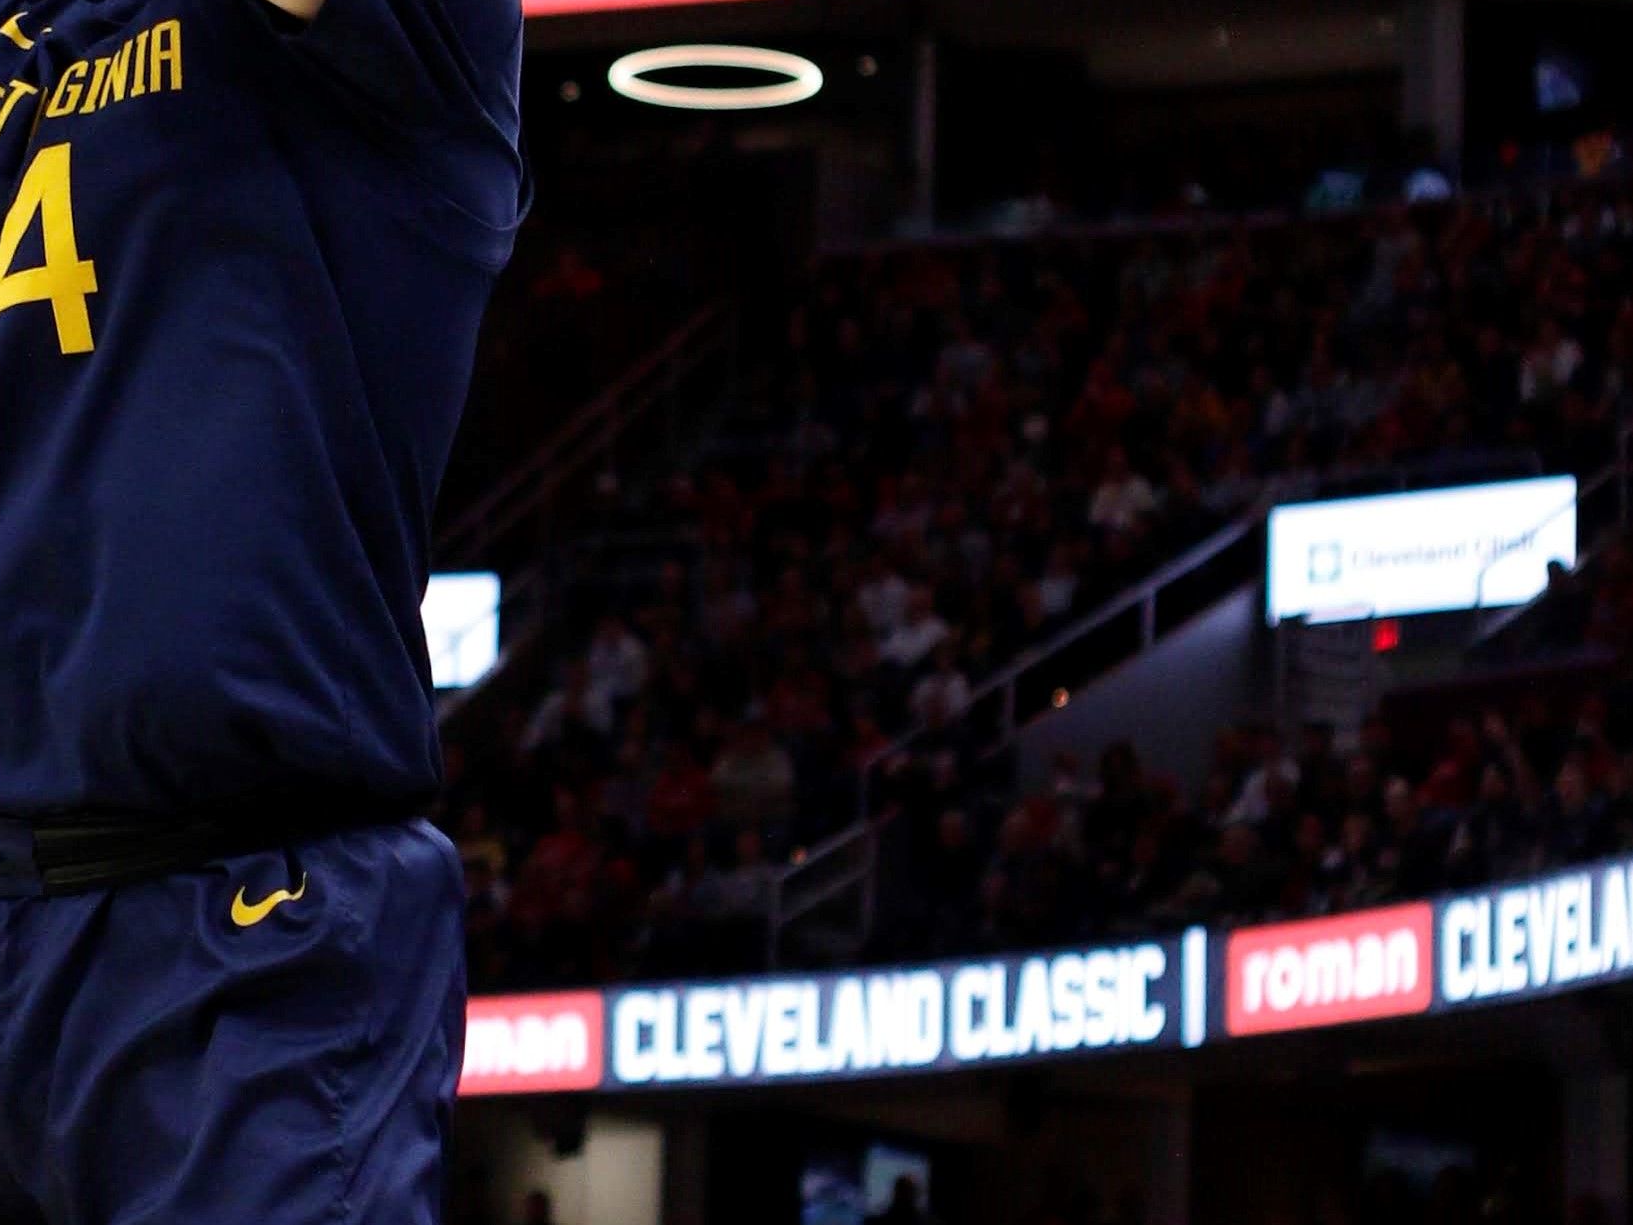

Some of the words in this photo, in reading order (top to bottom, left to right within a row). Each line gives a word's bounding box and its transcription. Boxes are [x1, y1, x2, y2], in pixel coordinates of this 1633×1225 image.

[1242, 928, 1419, 1015] roman
[1441, 858, 1633, 1003] CLEVELA
[463, 1012, 588, 1077] man
[611, 969, 944, 1084] CLEVELAND
[947, 943, 1167, 1062] CLASSIC
